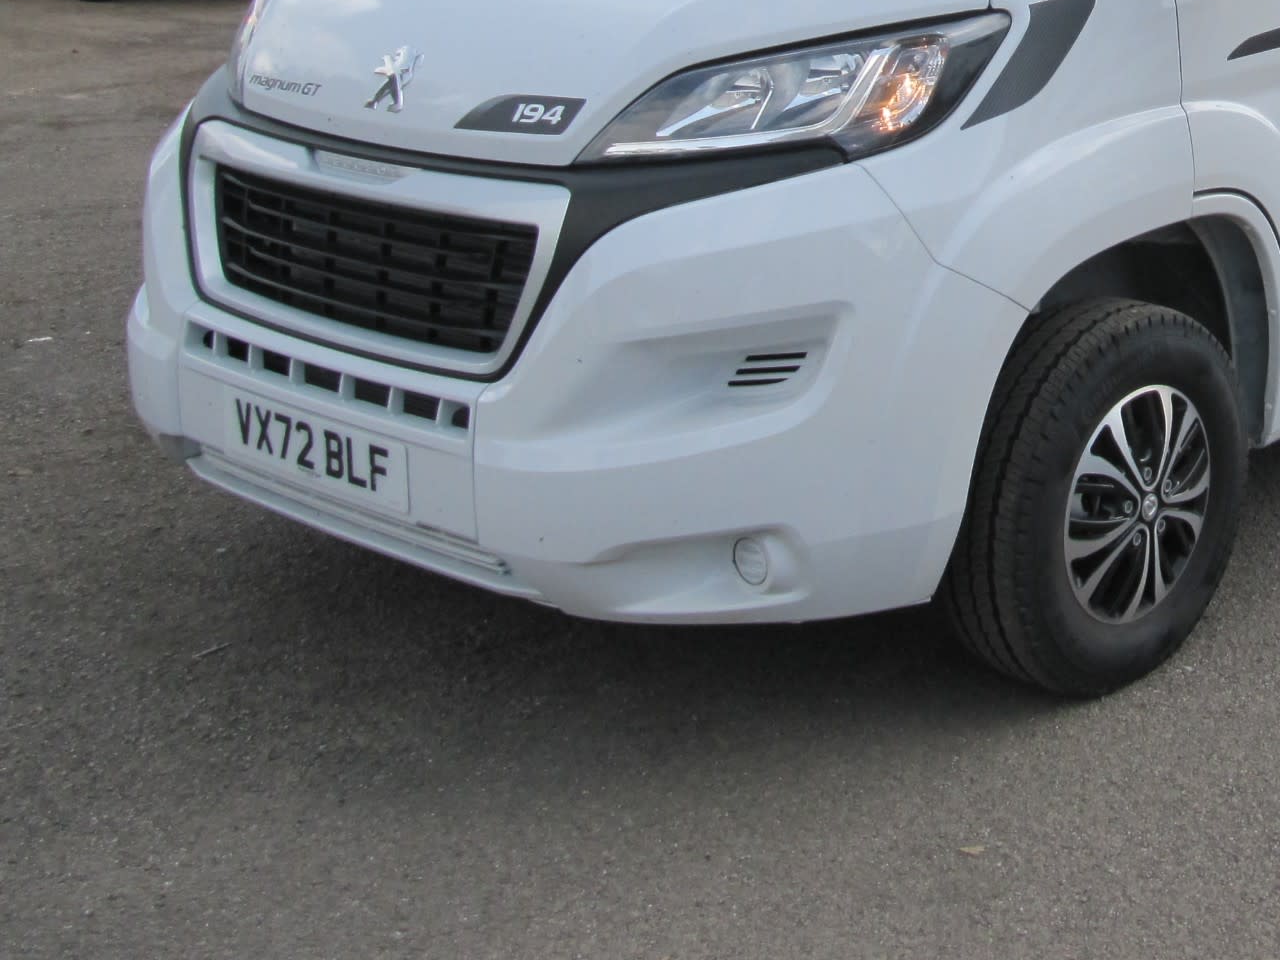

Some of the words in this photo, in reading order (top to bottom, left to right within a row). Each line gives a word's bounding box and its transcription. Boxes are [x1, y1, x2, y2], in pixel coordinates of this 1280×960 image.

[249, 74, 302, 92] magnum
[301, 82, 323, 97] GT
[511, 103, 566, 125] 194
[235, 398, 316, 471] VX72
[323, 428, 390, 493] BLF
